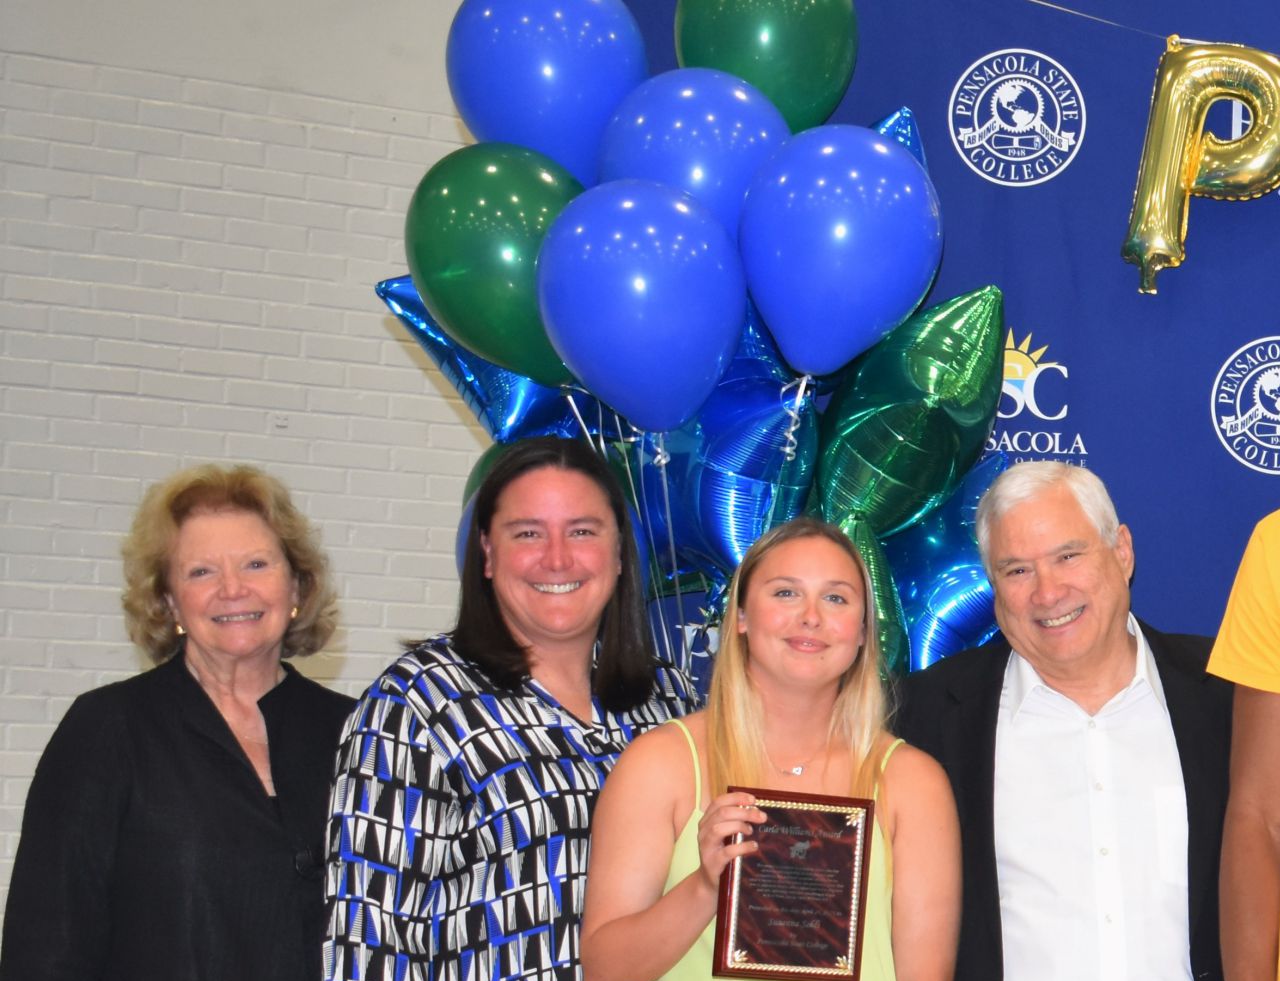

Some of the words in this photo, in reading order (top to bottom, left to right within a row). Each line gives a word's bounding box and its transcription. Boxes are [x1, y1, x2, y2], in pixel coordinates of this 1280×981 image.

[956, 56, 1041, 117] PENSACOLA
[1043, 68, 1079, 121] STATE
[970, 148, 1062, 181] COLLEGE
[1007, 148, 1026, 157] 1948
[996, 363, 1069, 421] SC
[985, 430, 1088, 455] SACOLA
